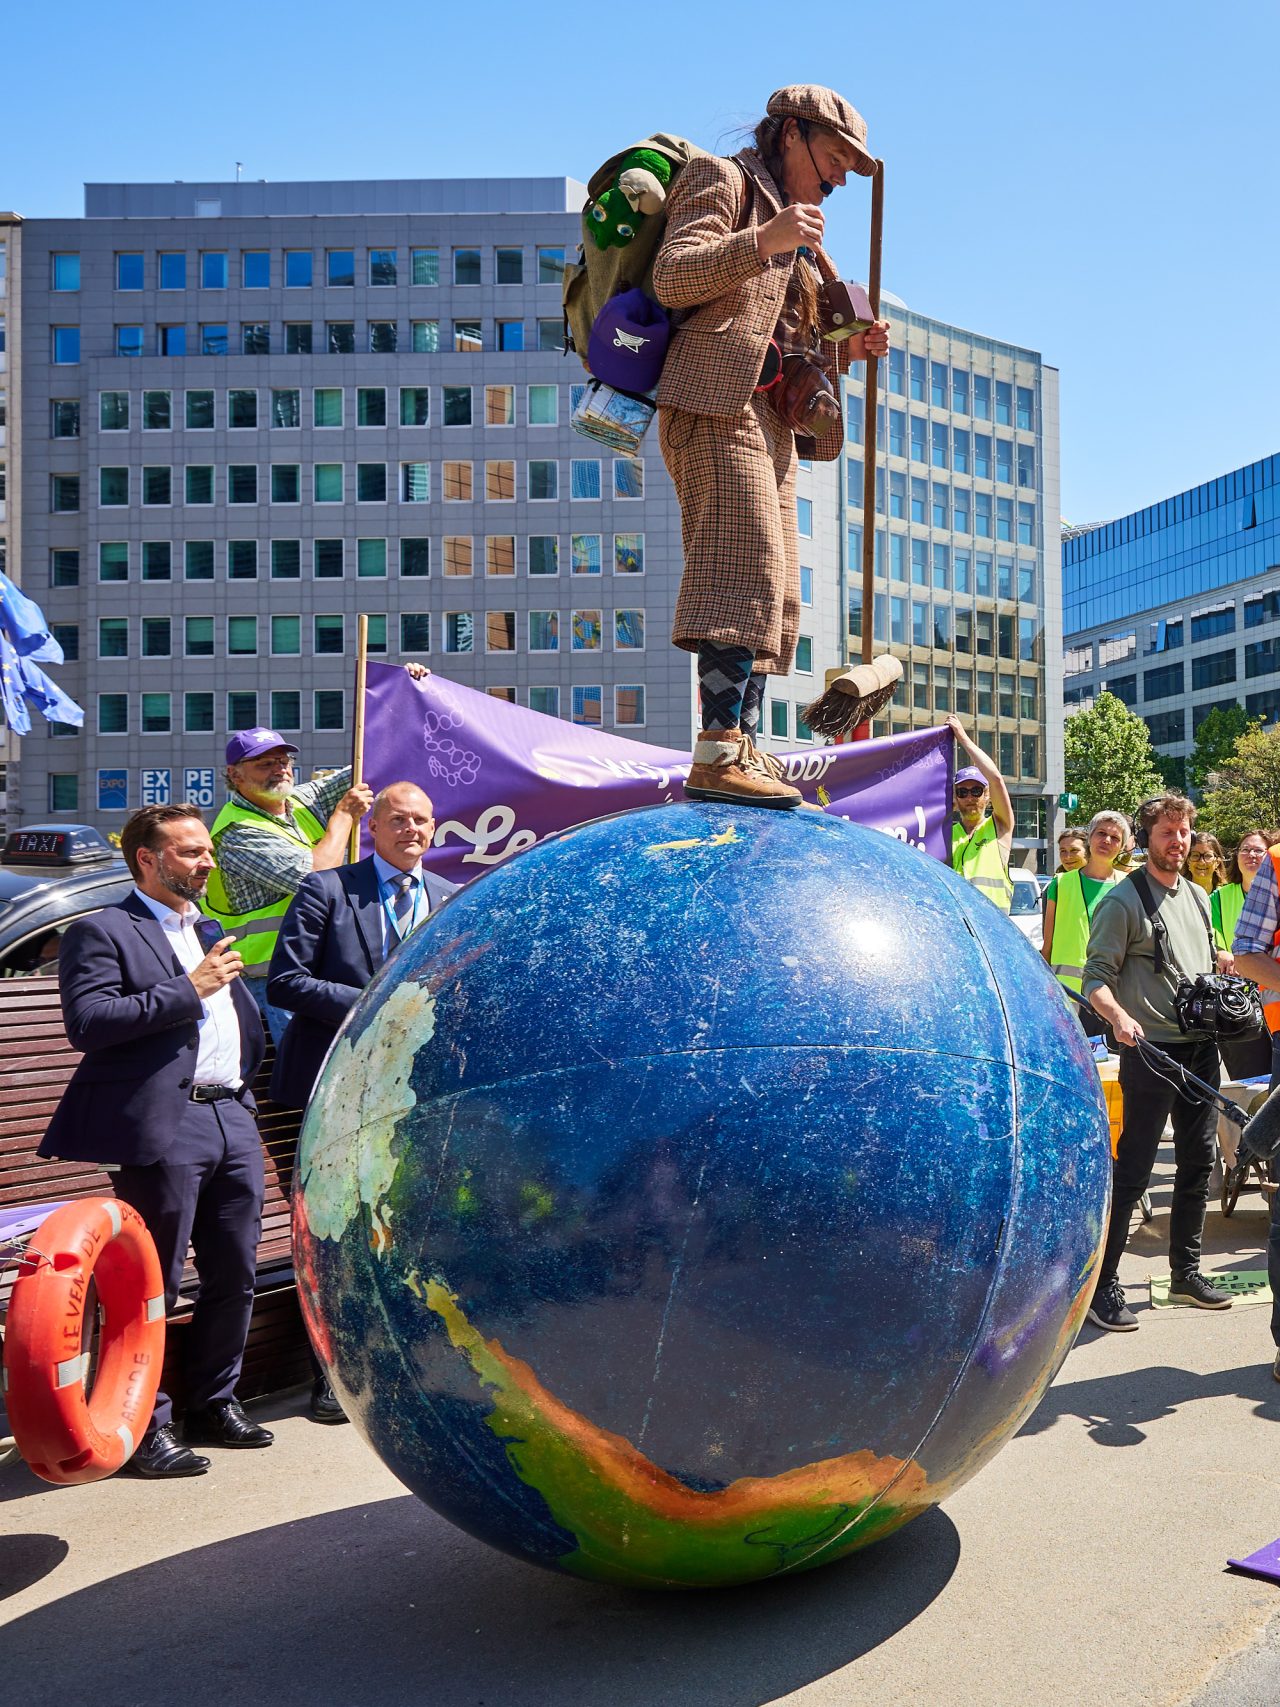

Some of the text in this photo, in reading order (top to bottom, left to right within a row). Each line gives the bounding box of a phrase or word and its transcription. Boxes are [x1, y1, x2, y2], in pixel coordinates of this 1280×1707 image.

[777, 752, 838, 782] oor
[99, 778, 126, 790] EXPO
[18, 834, 58, 852] TAXI
